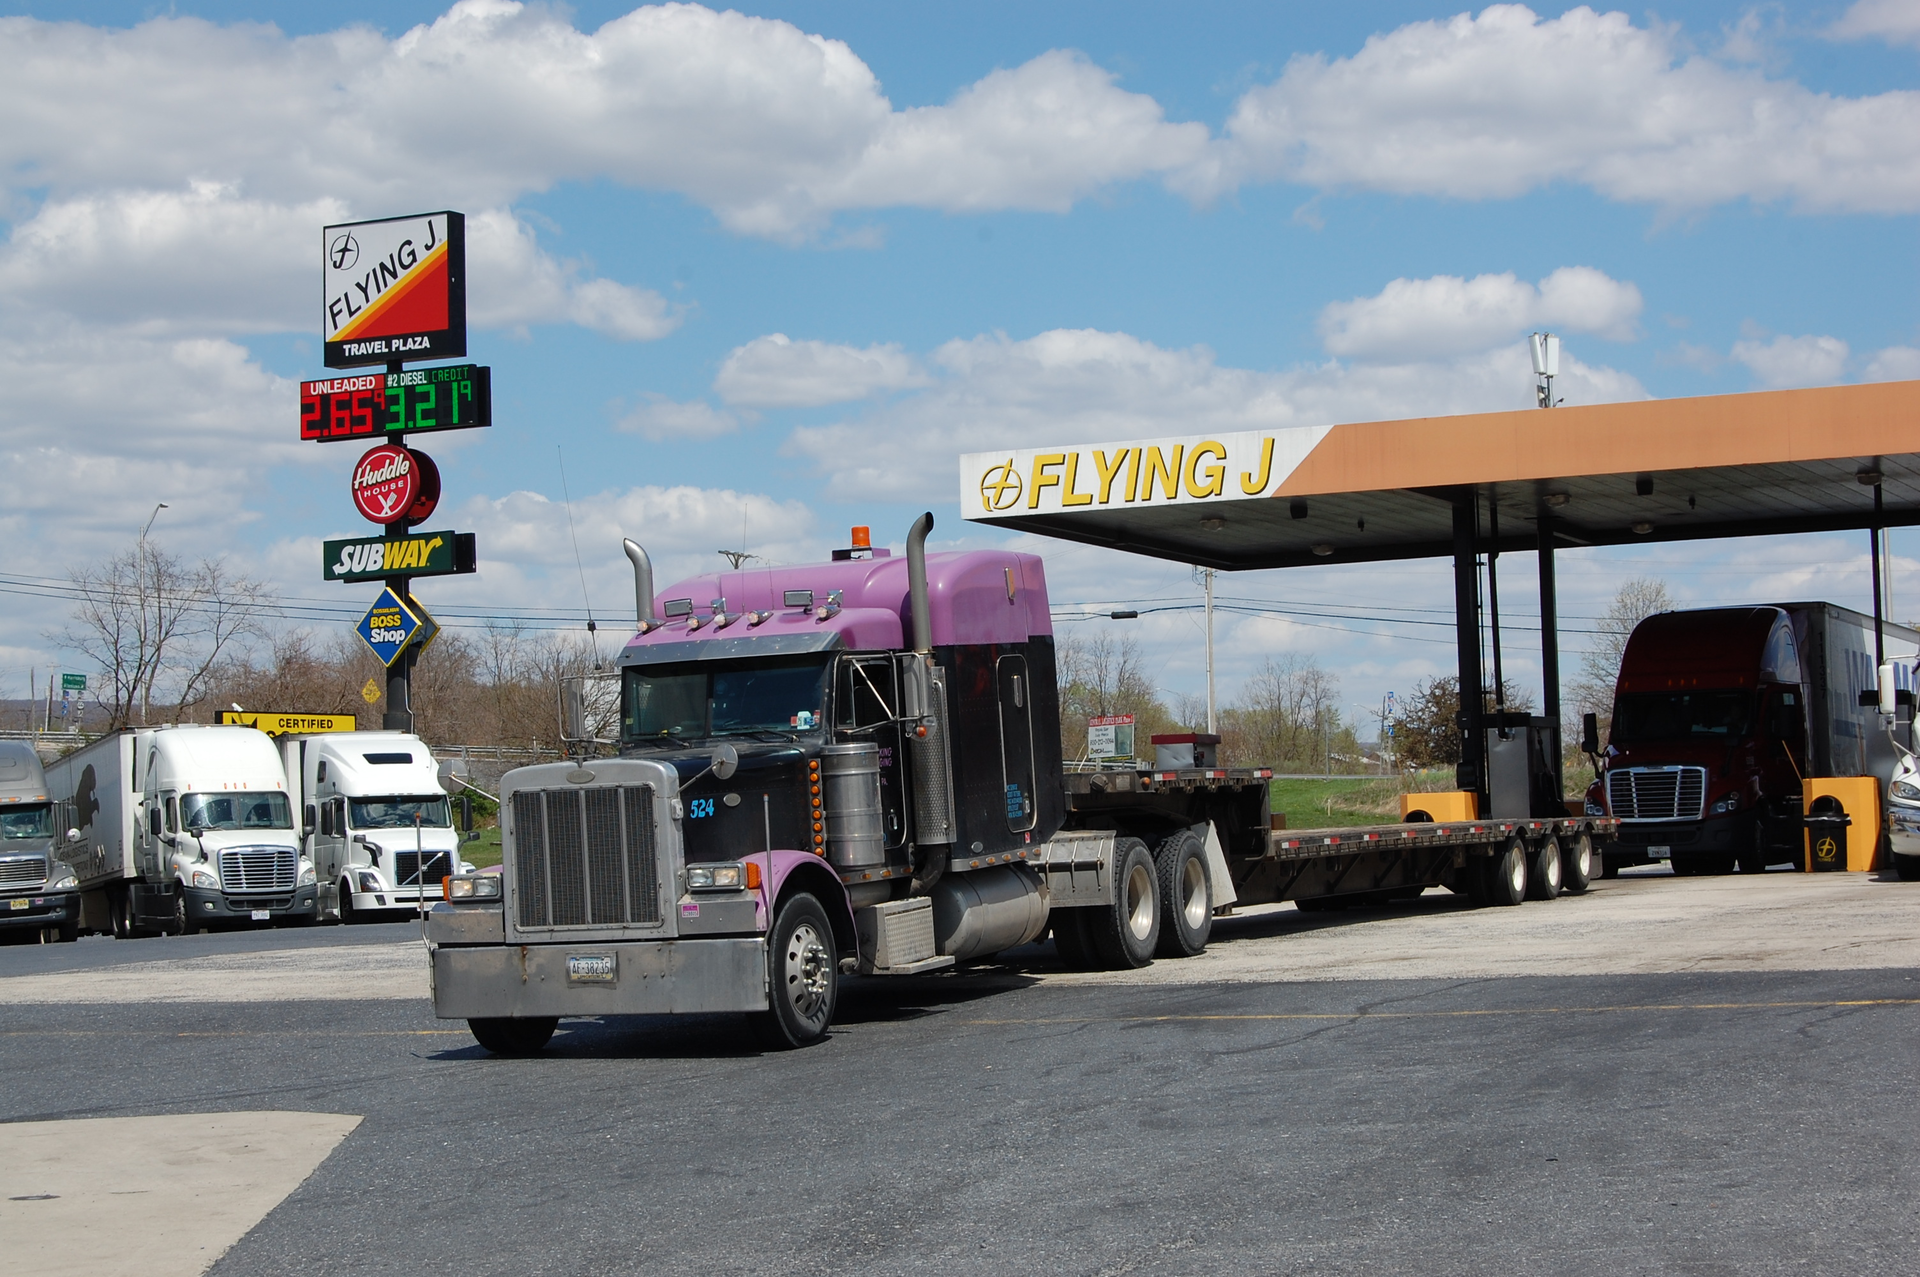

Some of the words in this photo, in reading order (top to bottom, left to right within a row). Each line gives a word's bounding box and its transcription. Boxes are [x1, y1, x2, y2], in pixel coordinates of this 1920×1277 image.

[328, 239, 418, 331] FLYING
[424, 219, 437, 252] J
[343, 340, 388, 357] TRAVEL
[392, 336, 431, 352] PLAZA
[387, 374, 398, 387] #2
[400, 370, 428, 386] DIESEL
[431, 366, 470, 383] CREDIT
[310, 376, 376, 395] UNLEADED
[353, 453, 410, 489] Huddle
[1027, 440, 1228, 510] FLYING
[1240, 437, 1275, 495] J
[364, 480, 405, 498] HOUSE
[332, 535, 443, 576] SUBWAY
[370, 614, 402, 628] BOSS
[370, 628, 406, 645] Shop
[278, 718, 334, 729] CERTIFIED
[690, 798, 715, 819] 524
